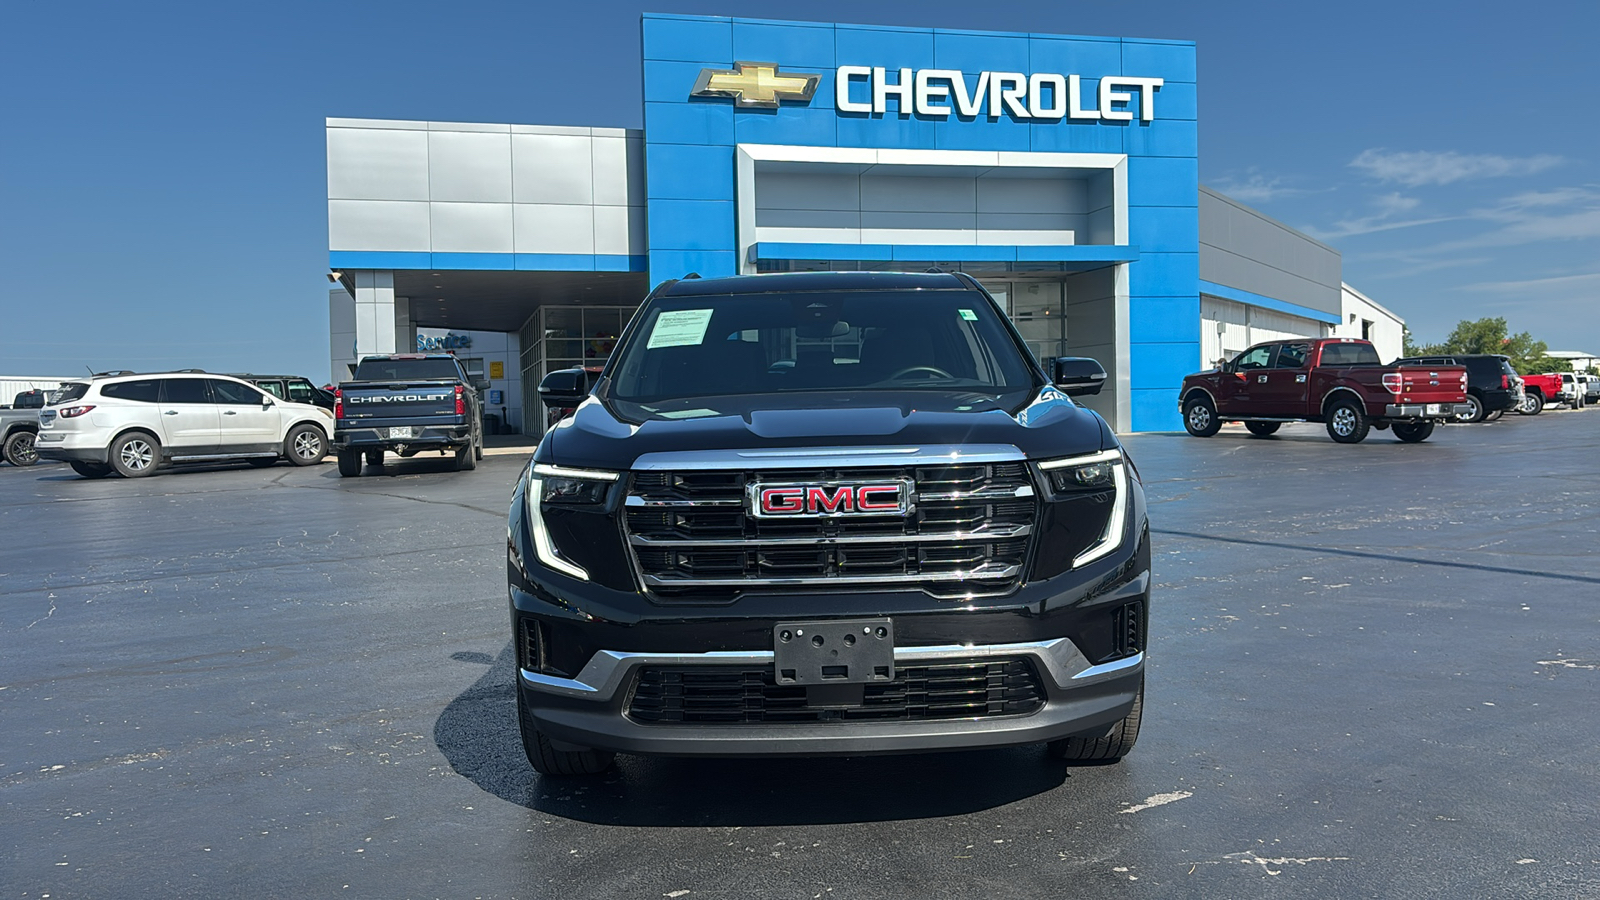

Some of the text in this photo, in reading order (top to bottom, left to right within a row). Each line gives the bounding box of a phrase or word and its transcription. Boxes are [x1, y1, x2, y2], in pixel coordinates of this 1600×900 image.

[836, 65, 1164, 121] CHEVROLET
[417, 332, 469, 351] Service
[350, 394, 448, 404] CHEVROLET
[761, 485, 900, 514] GMC
